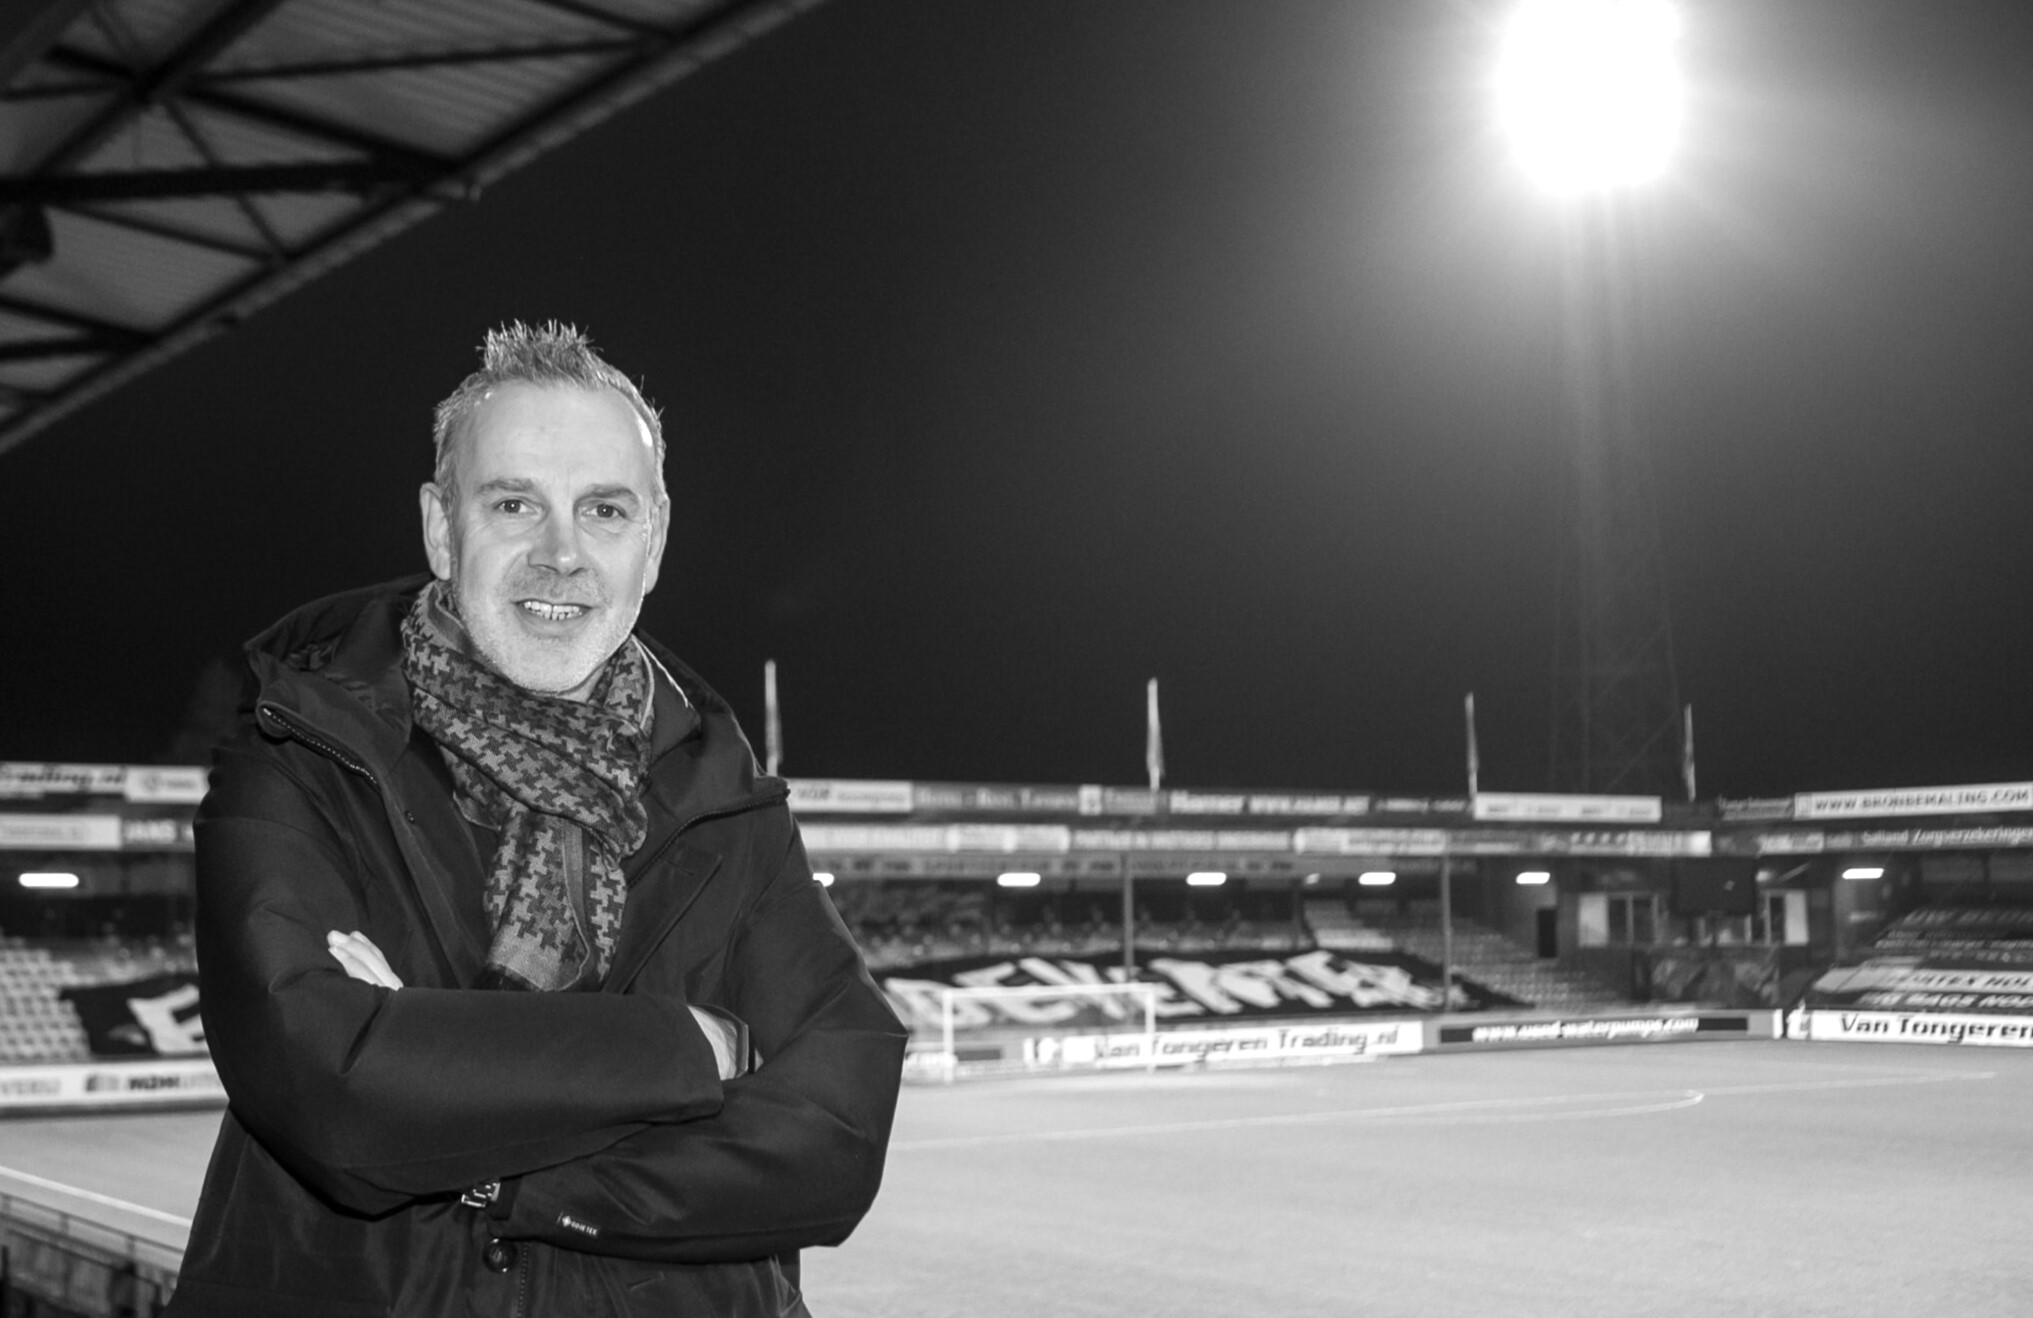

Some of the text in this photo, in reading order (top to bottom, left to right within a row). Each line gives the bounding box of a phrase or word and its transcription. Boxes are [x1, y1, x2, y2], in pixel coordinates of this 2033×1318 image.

[1841, 1013, 2033, 1044] Van Tongeren
[1096, 1035, 1140, 1059] Van
[1151, 1032, 1267, 1062] Tongeren
